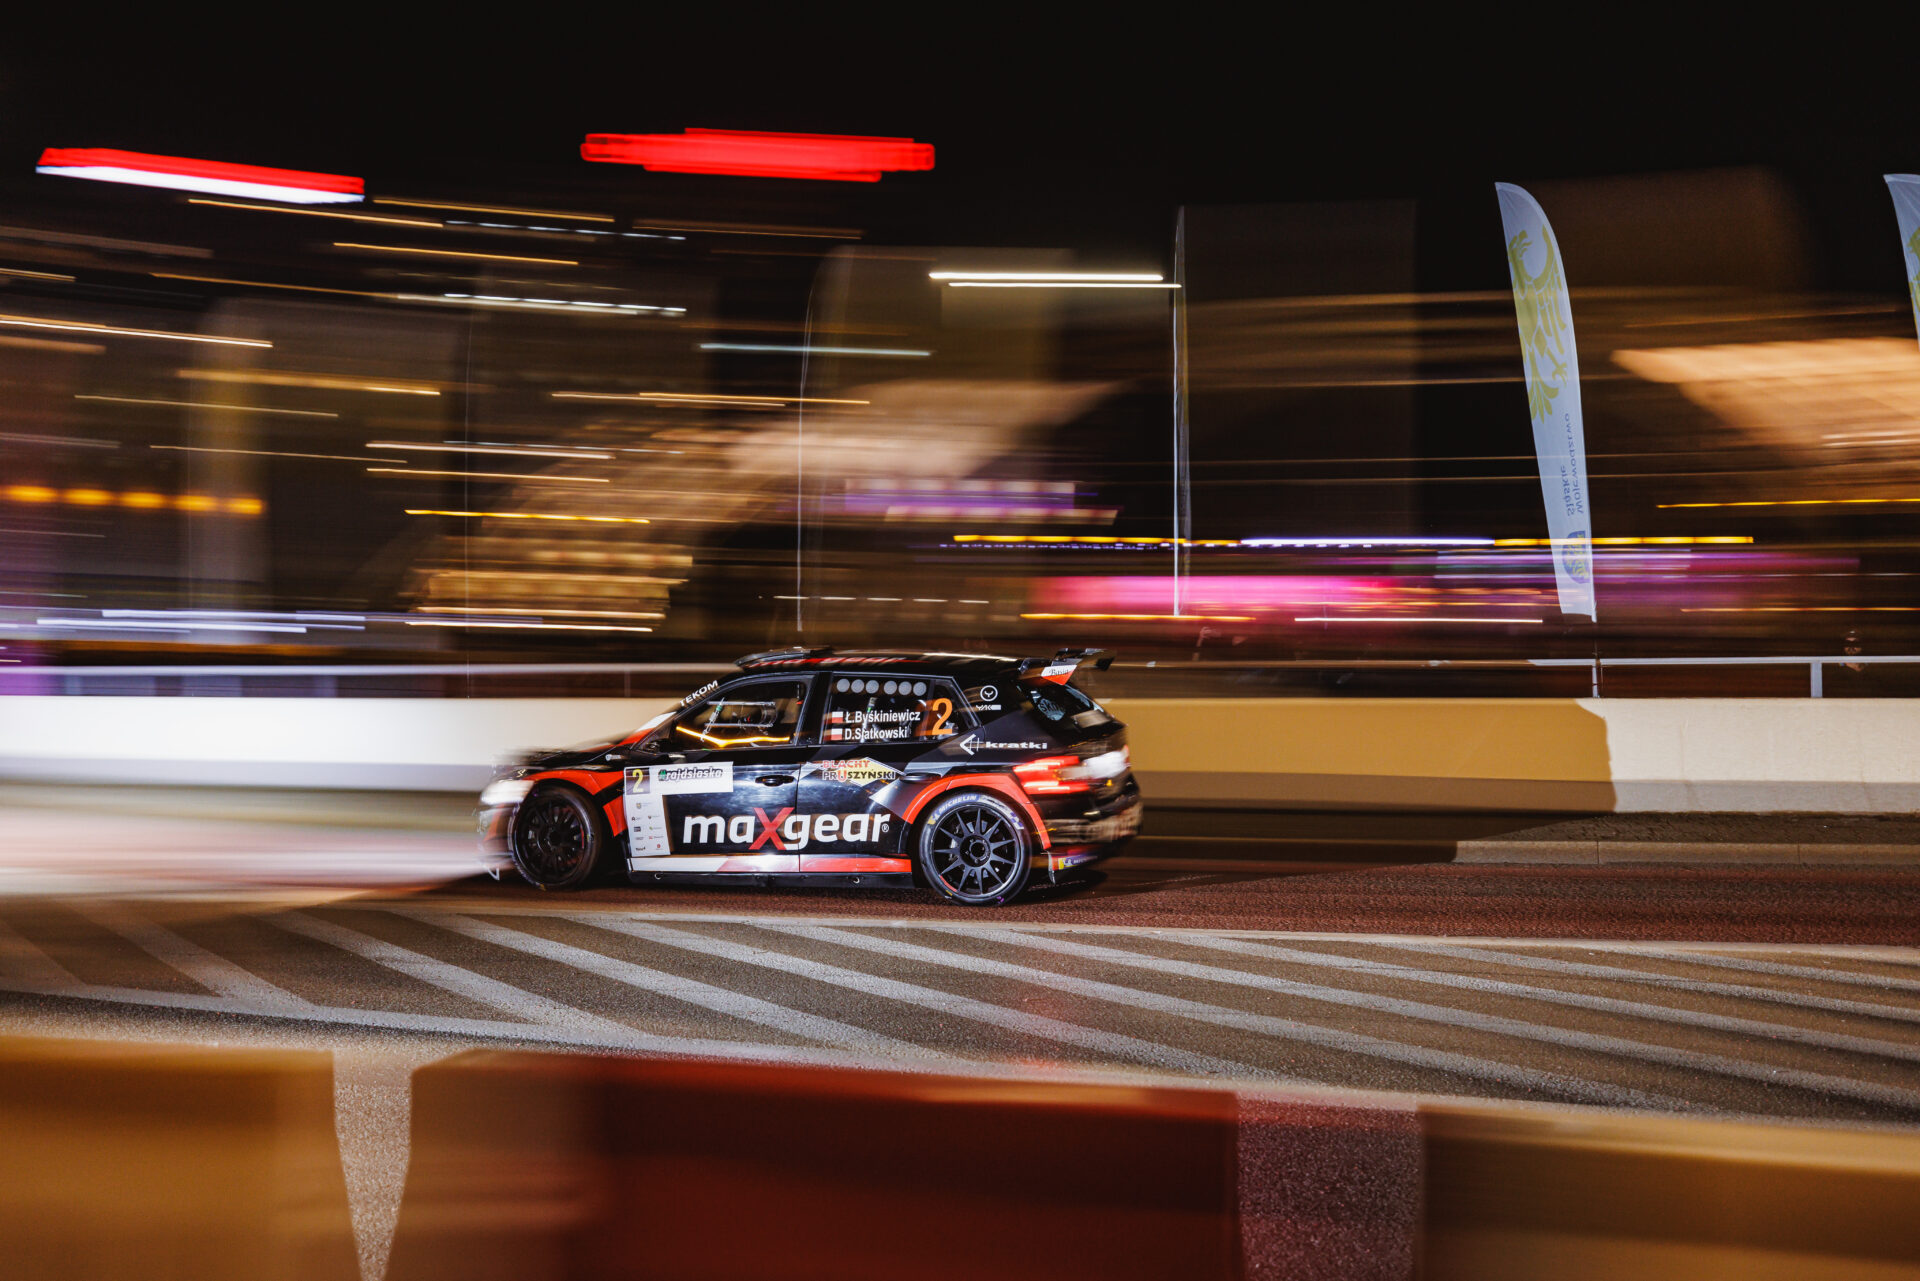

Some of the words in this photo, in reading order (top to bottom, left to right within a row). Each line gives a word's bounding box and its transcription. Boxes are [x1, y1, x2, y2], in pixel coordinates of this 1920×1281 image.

[845, 709, 921, 724] Ł.Byśkiniewicz
[931, 697, 953, 735] 2
[985, 741, 1048, 749] kratki
[632, 769, 644, 793] 2
[822, 770, 897, 782] PRUSZYŃSKI
[938, 795, 977, 813] MICHELIN
